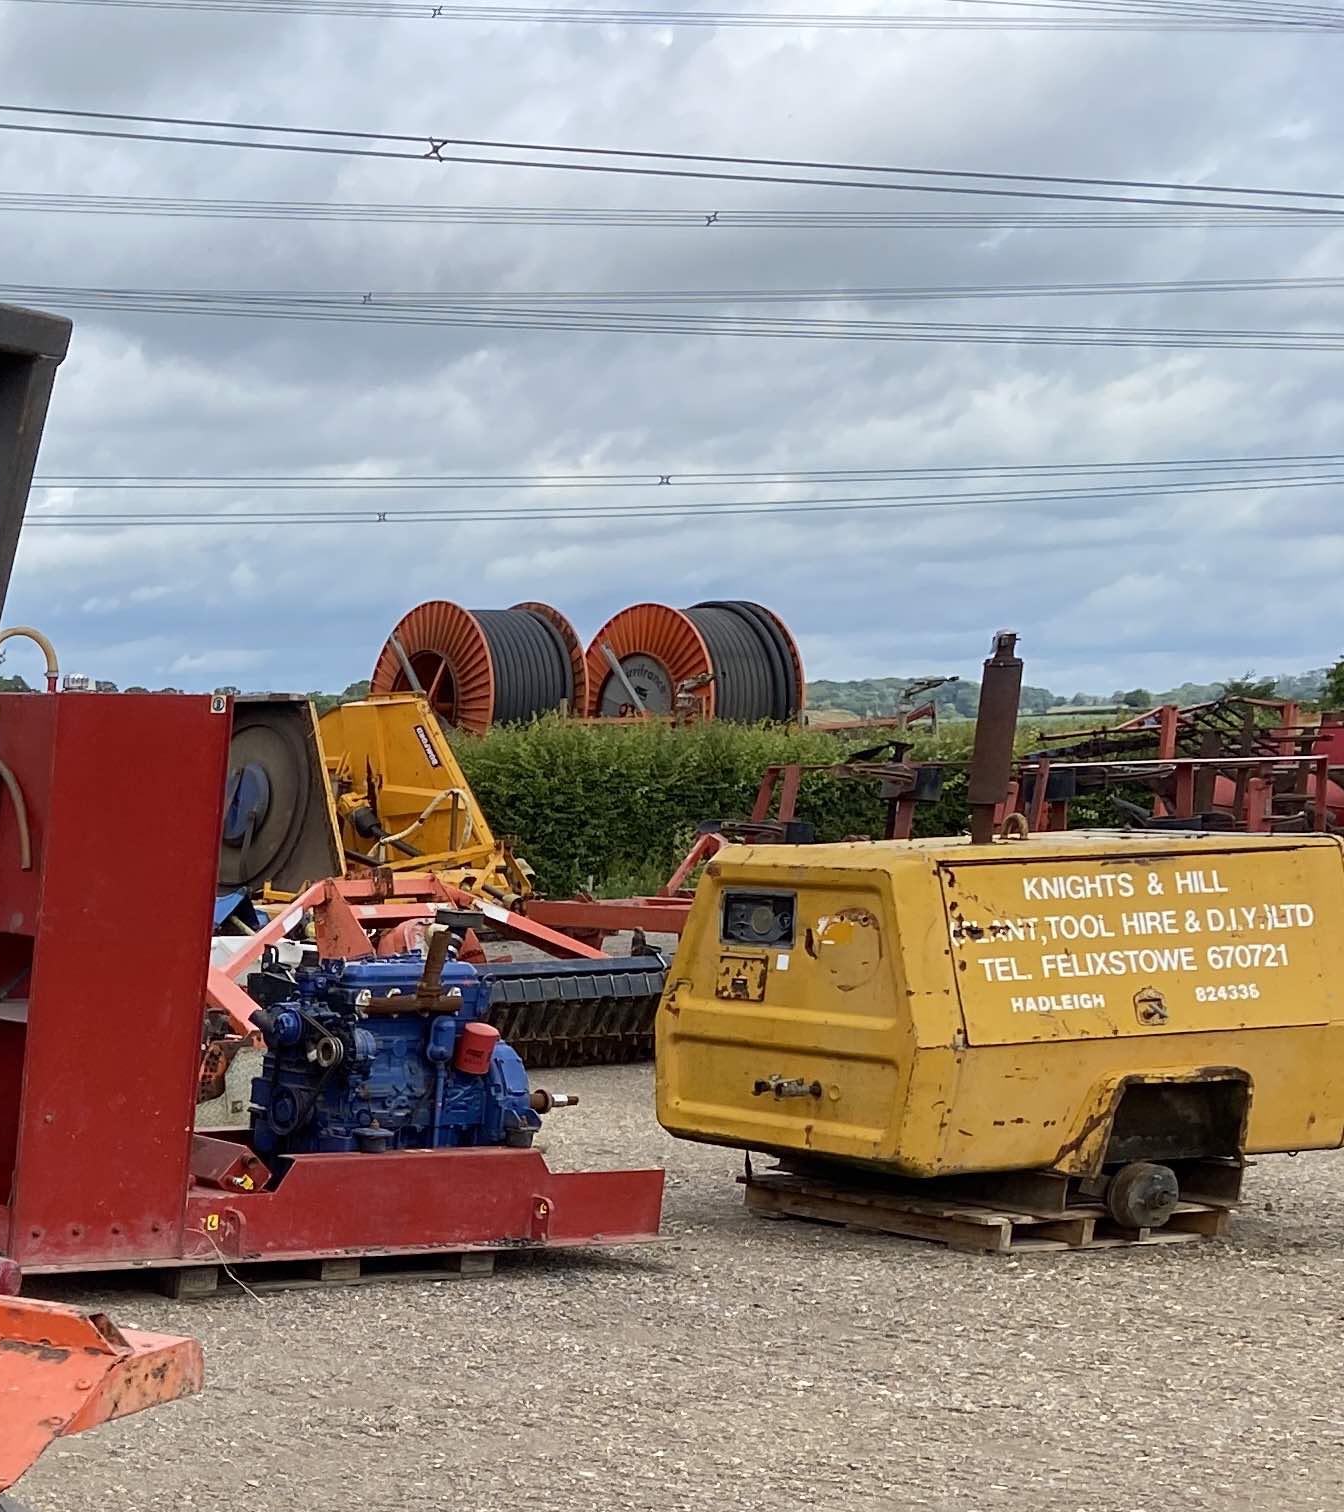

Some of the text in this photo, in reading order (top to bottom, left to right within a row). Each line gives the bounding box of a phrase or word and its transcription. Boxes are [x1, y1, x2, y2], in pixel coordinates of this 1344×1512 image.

[1023, 870, 1229, 900] KNIGHTS & HILL
[1122, 910, 1179, 935] HIRE
[1185, 909, 1202, 933] &
[978, 944, 1289, 982] TEL. FELIXSTOWE 670721
[1011, 993, 1105, 1013] HADLEIGH
